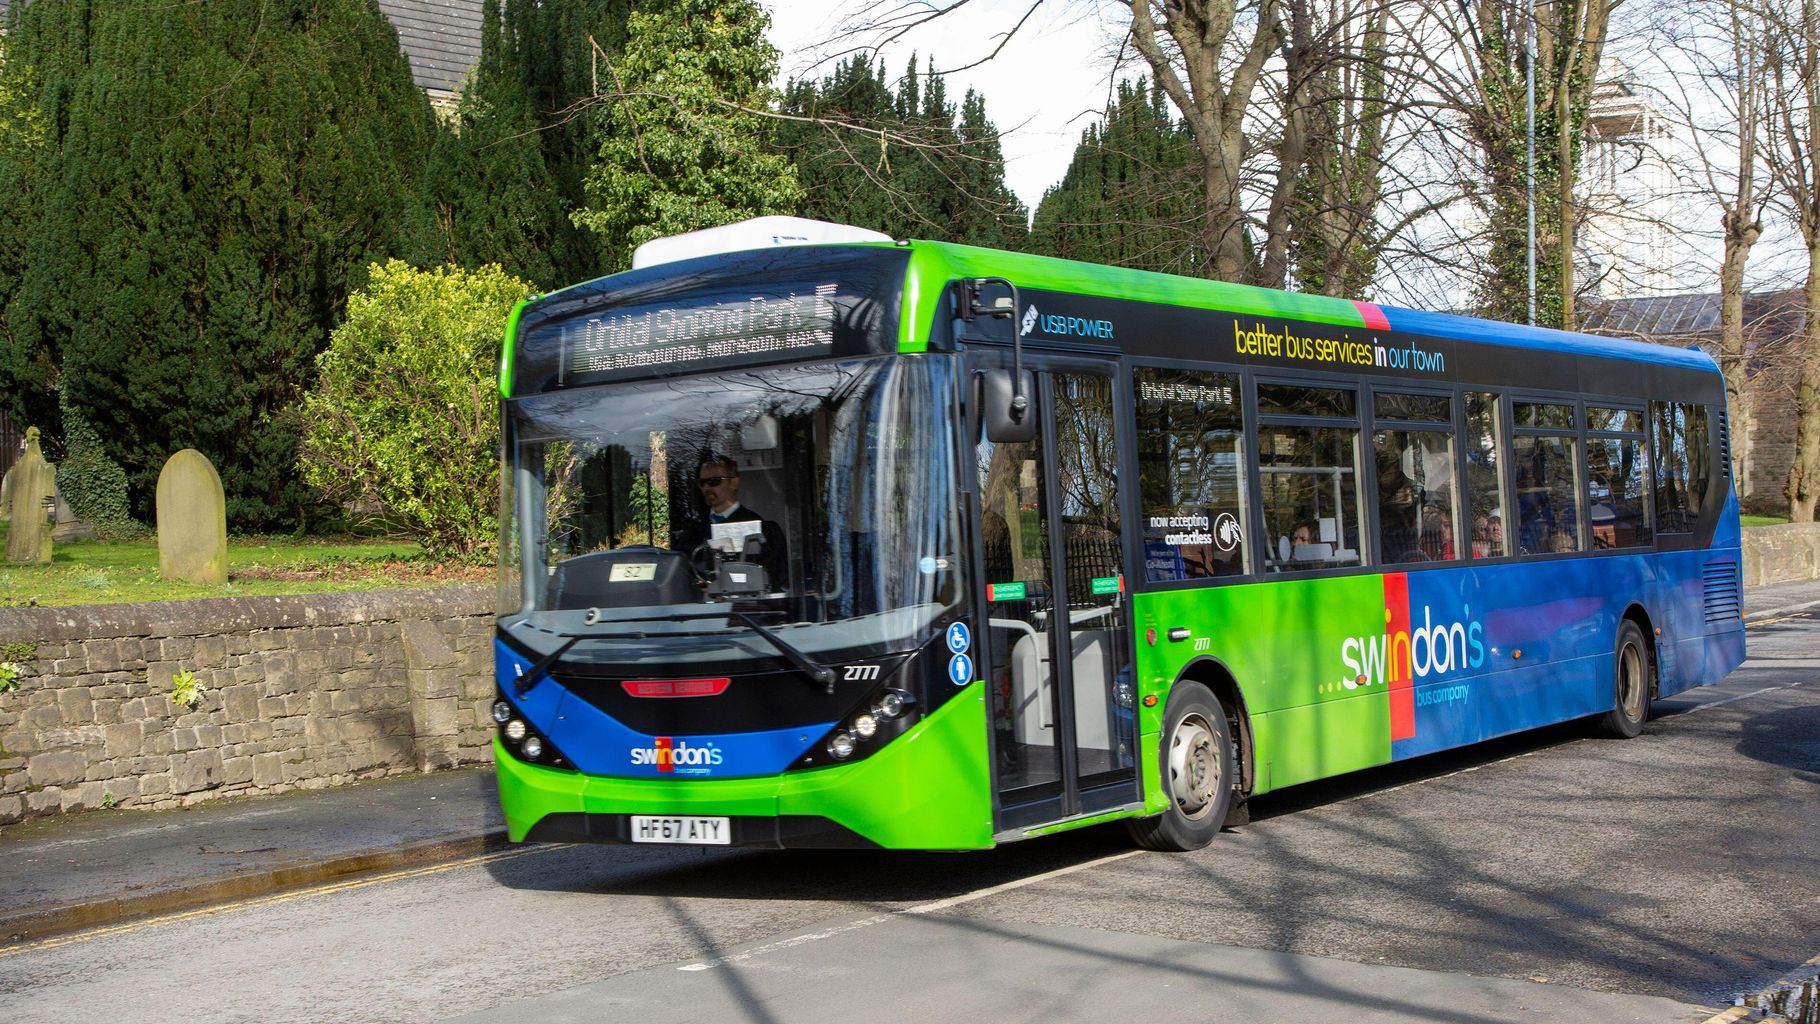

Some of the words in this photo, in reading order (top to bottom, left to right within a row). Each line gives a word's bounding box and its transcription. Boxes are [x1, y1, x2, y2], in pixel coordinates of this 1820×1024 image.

[584, 311, 653, 352] Orbital
[656, 302, 744, 344] Shopping
[749, 292, 803, 333] Park
[1040, 313, 1068, 336] USB
[1067, 316, 1115, 339] POWER
[1233, 319, 1284, 357] better
[1285, 325, 1314, 361] bus
[1314, 333, 1374, 366] services
[1373, 336, 1388, 368] in
[1388, 346, 1411, 370] our
[1411, 341, 1445, 373] town
[1140, 381, 1175, 400] Orbital
[1199, 385, 1221, 403] Park
[1150, 515, 1169, 528] now
[1169, 512, 1209, 531] accepting
[1164, 529, 1213, 546] contactless
[843, 665, 881, 680] 2777
[1416, 689, 1433, 708] bus
[1432, 683, 1470, 707] company
[630, 740, 724, 765] swindon's
[640, 819, 682, 839] HF67
[689, 820, 720, 840] ATY
